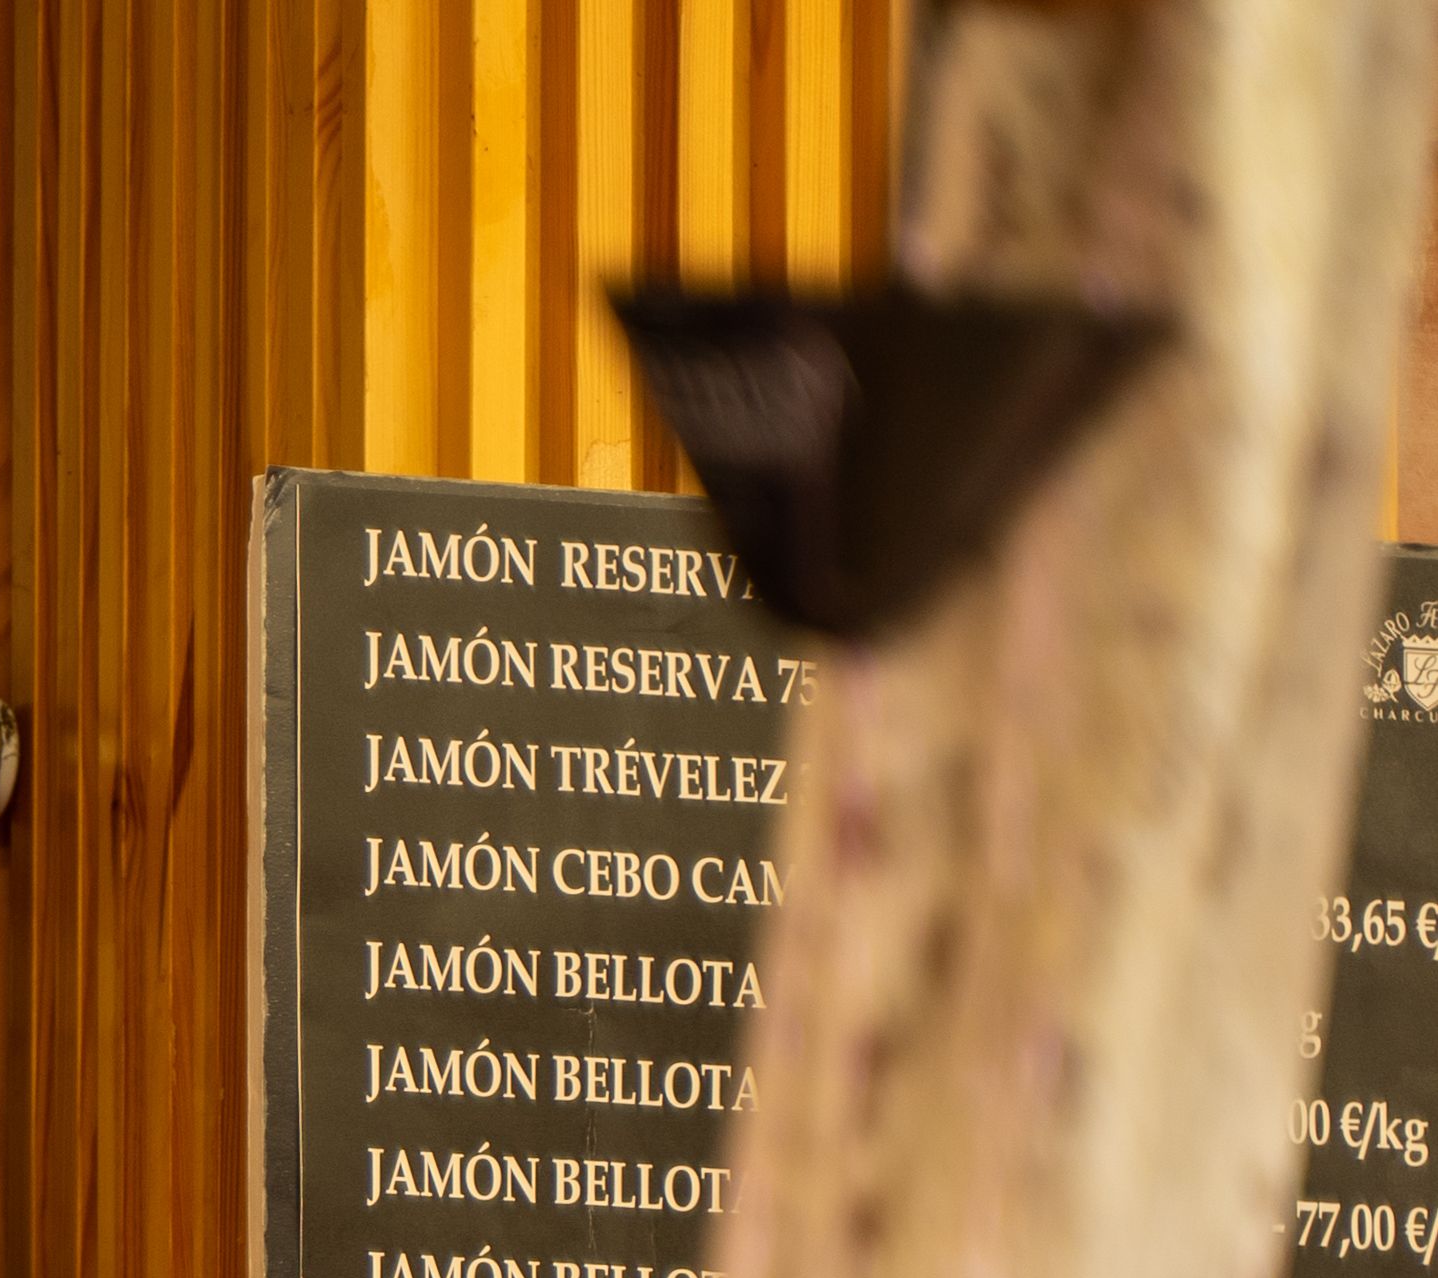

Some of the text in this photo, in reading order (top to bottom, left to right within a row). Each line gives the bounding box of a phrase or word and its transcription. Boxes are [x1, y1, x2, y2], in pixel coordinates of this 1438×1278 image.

[363, 523, 761, 600] JAMÓN RESERV
[363, 625, 539, 690] JAMÓN
[549, 642, 768, 704] RESERVA
[364, 728, 788, 805] JAMÓN TRÉVELEZ
[364, 832, 540, 896] JAMÓN
[552, 847, 680, 902] CEBO
[365, 934, 767, 1010] JAMÓN BELLOTA
[365, 1038, 761, 1112] JAMÓN BELLOTA
[1340, 1101, 1429, 1167] €/kg
[366, 1142, 742, 1214] JAMÓN BELLOT
[1296, 1200, 1396, 1259] 77,00
